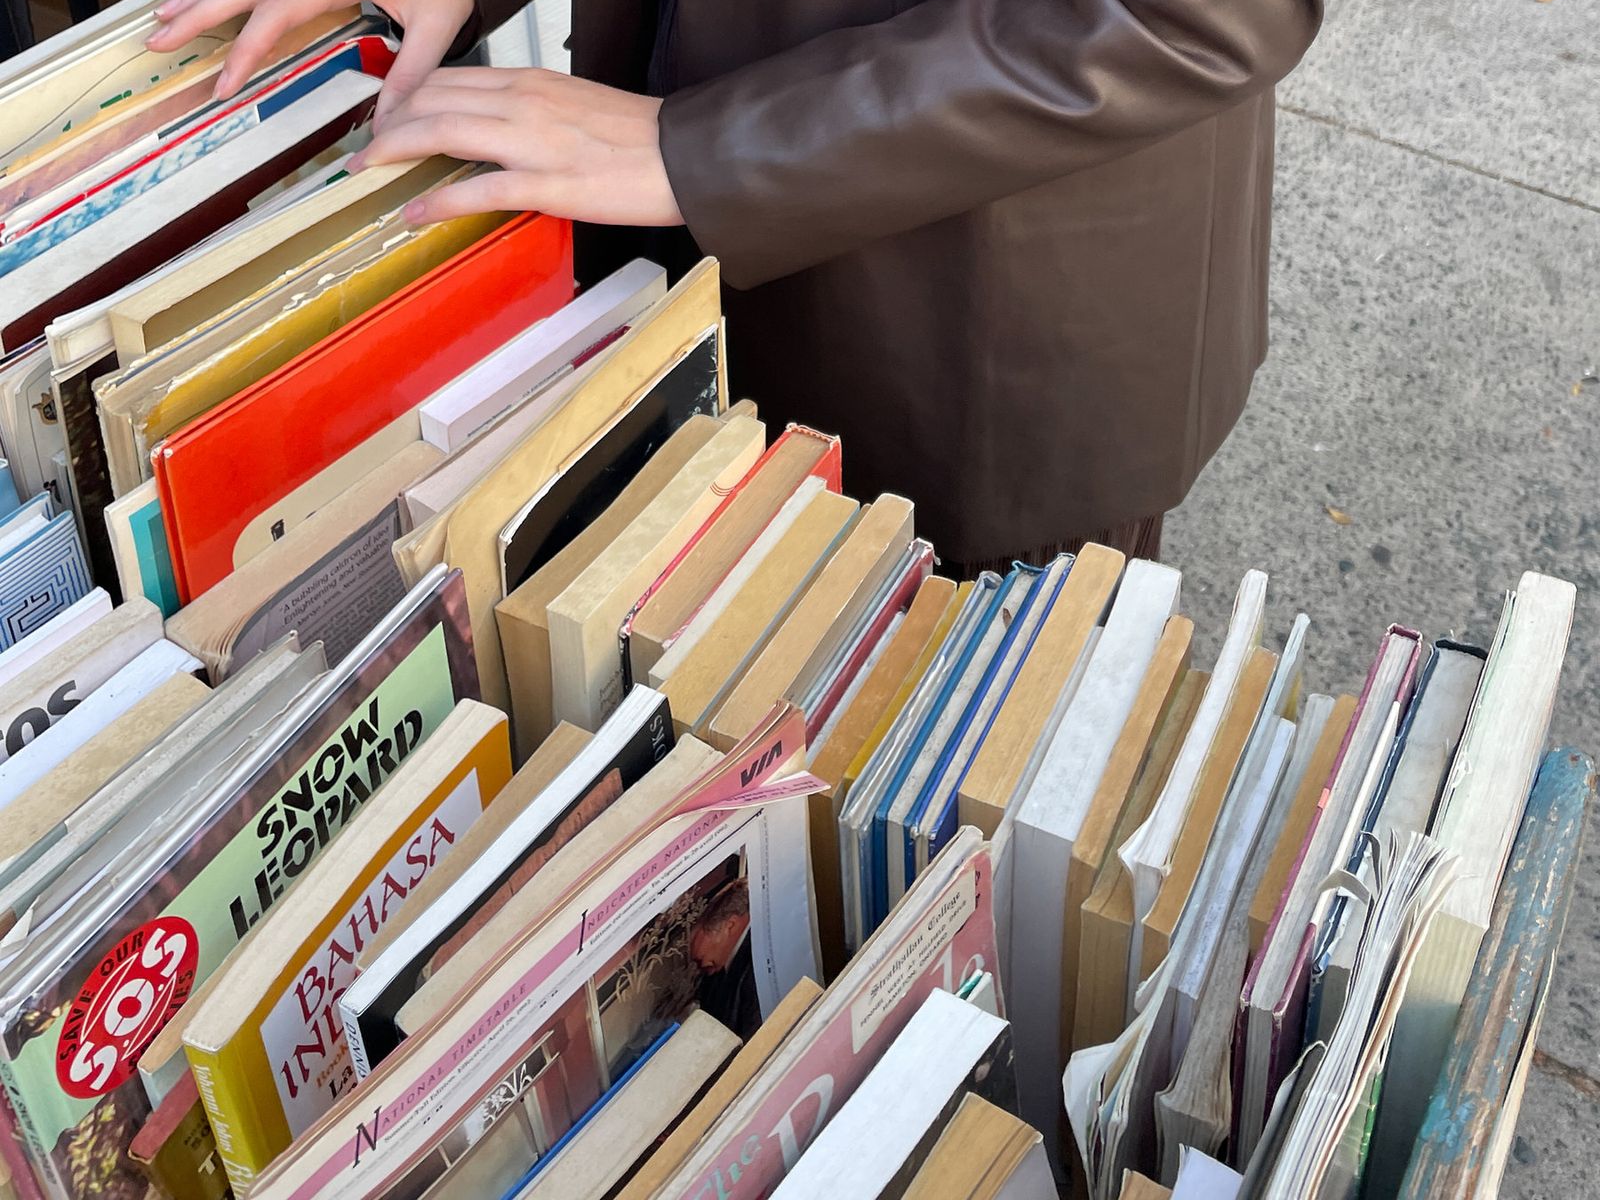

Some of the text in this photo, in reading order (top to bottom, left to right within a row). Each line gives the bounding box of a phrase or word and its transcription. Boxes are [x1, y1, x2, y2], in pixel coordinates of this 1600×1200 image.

[284, 580, 337, 624] Enlightening
[339, 566, 354, 581] and
[291, 574, 329, 607] bubbling
[363, 536, 373, 552] of
[257, 696, 378, 859] SNOW
[740, 740, 782, 788] VIA
[229, 710, 423, 940] LEOPARD
[293, 817, 455, 1024] BAHASA
[577, 863, 657, 956] INDICATEUR
[928, 892, 961, 931] College
[59, 931, 144, 1060] SAVE OUR
[353, 983, 526, 1169] NATIONAL TIMETABLE
